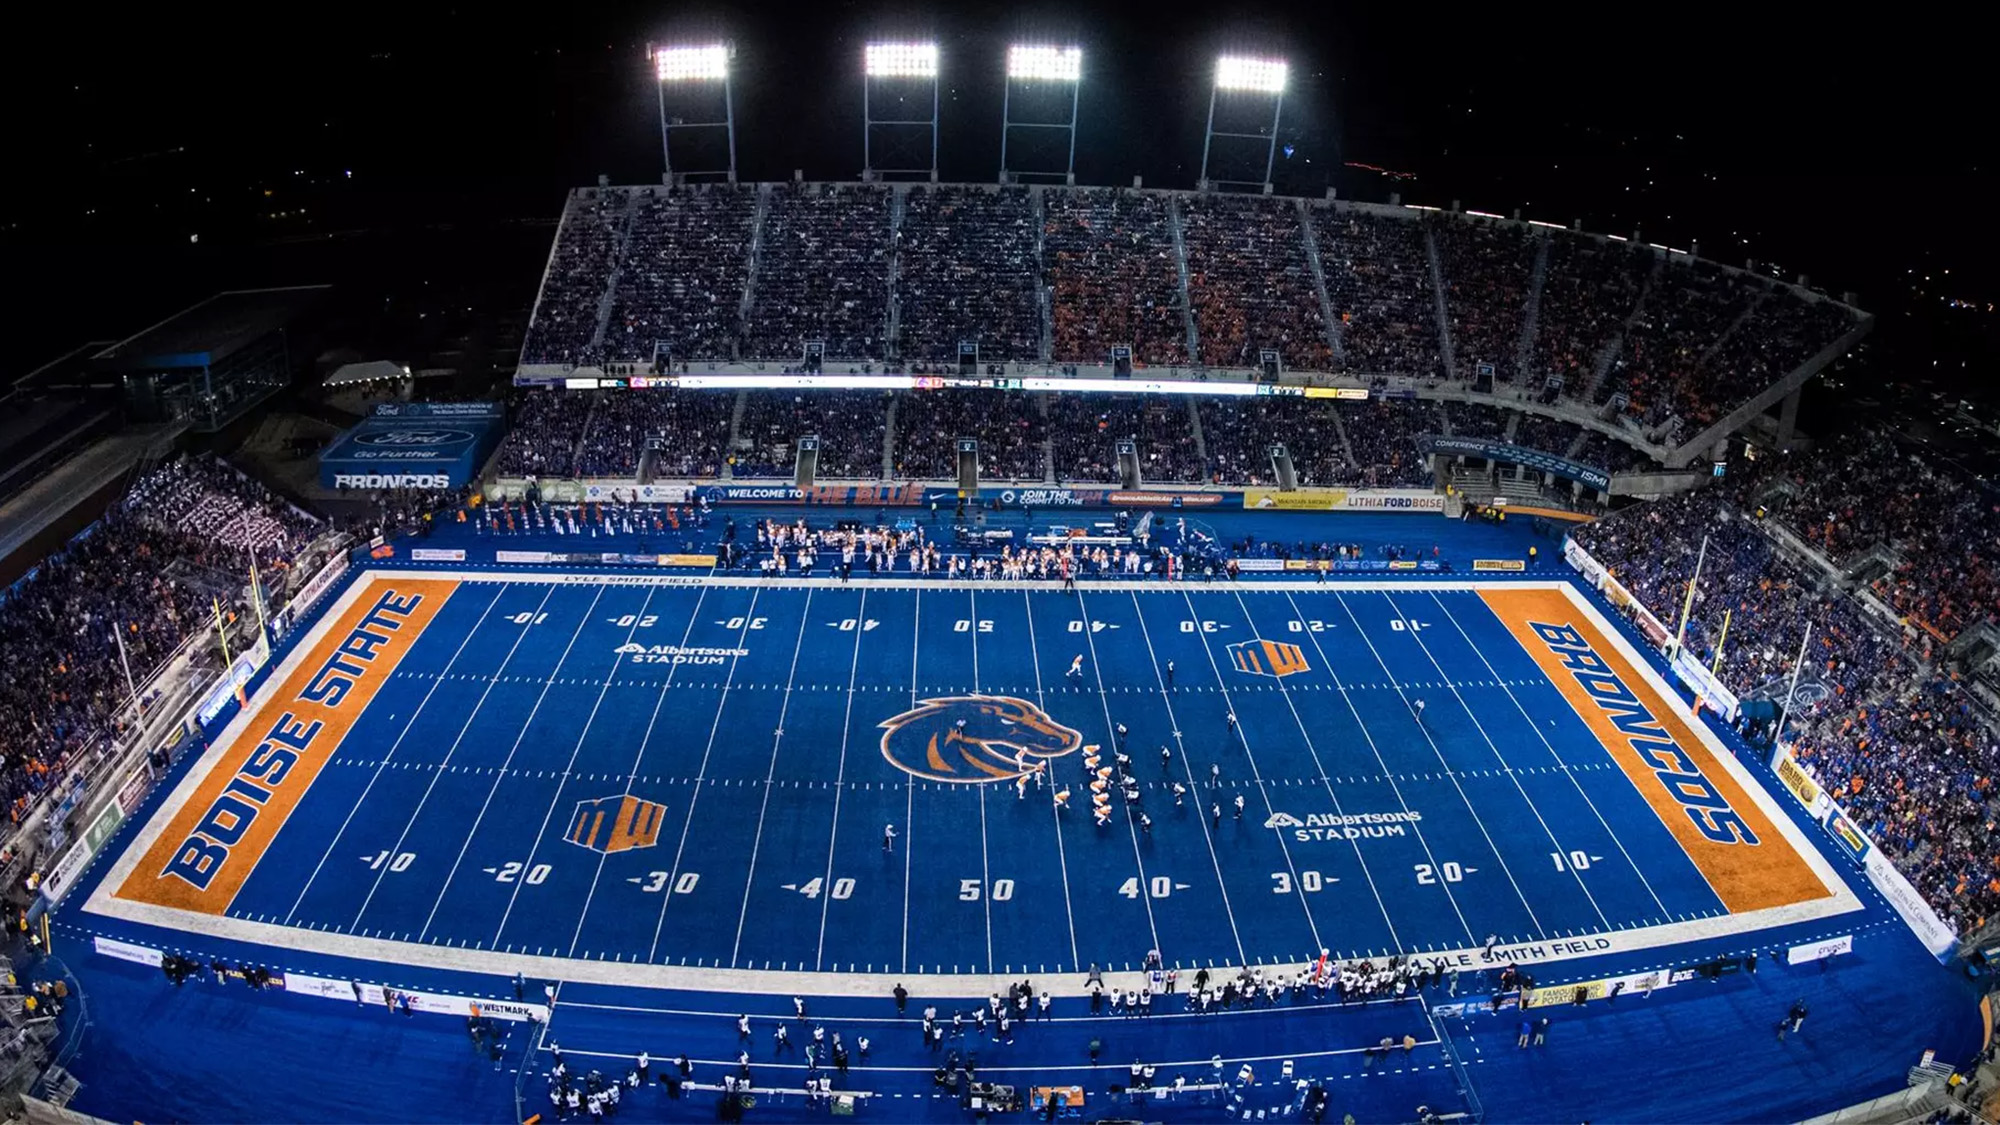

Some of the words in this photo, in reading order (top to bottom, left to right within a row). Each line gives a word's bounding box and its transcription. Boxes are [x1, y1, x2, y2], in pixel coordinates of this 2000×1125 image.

[375, 404, 399, 416] Ford
[374, 430, 452, 444] Ford
[1435, 439, 1485, 450] CONFERENCE
[378, 450, 439, 458] Further
[334, 474, 449, 489] BRONCOS
[728, 489, 785, 498] WELCOME
[788, 489, 804, 498] TO
[797, 485, 850, 504] THE
[853, 482, 926, 505] BLUE
[1020, 490, 1049, 500] JOIN
[1050, 490, 1072, 499] THE
[1348, 497, 1442, 508] LITHIAFORDBOISE
[293, 589, 424, 709] STATE
[631, 654, 725, 665] STADIUM
[647, 644, 749, 657] Albertsons
[1526, 621, 1762, 846] BRONCOS
[1780, 758, 1804, 785] IDAHO
[157, 711, 325, 891] BOISE
[1305, 810, 1422, 827] Albertsons
[1295, 824, 1405, 842] STADIUM
[369, 850, 417, 873] 10
[1550, 850, 1591, 872] 10
[495, 862, 552, 885] 20
[642, 871, 700, 894] 30
[1271, 871, 1322, 893] 30
[1414, 862, 1463, 885] 20
[799, 877, 857, 900] 40
[958, 878, 1014, 901] 50
[1117, 876, 1171, 899] 40
[1482, 946, 1546, 964] SMITH
[1551, 938, 1611, 956] FIELD
[1817, 940, 1848, 955] crunch
[483, 1002, 530, 1016] WESTMARK
